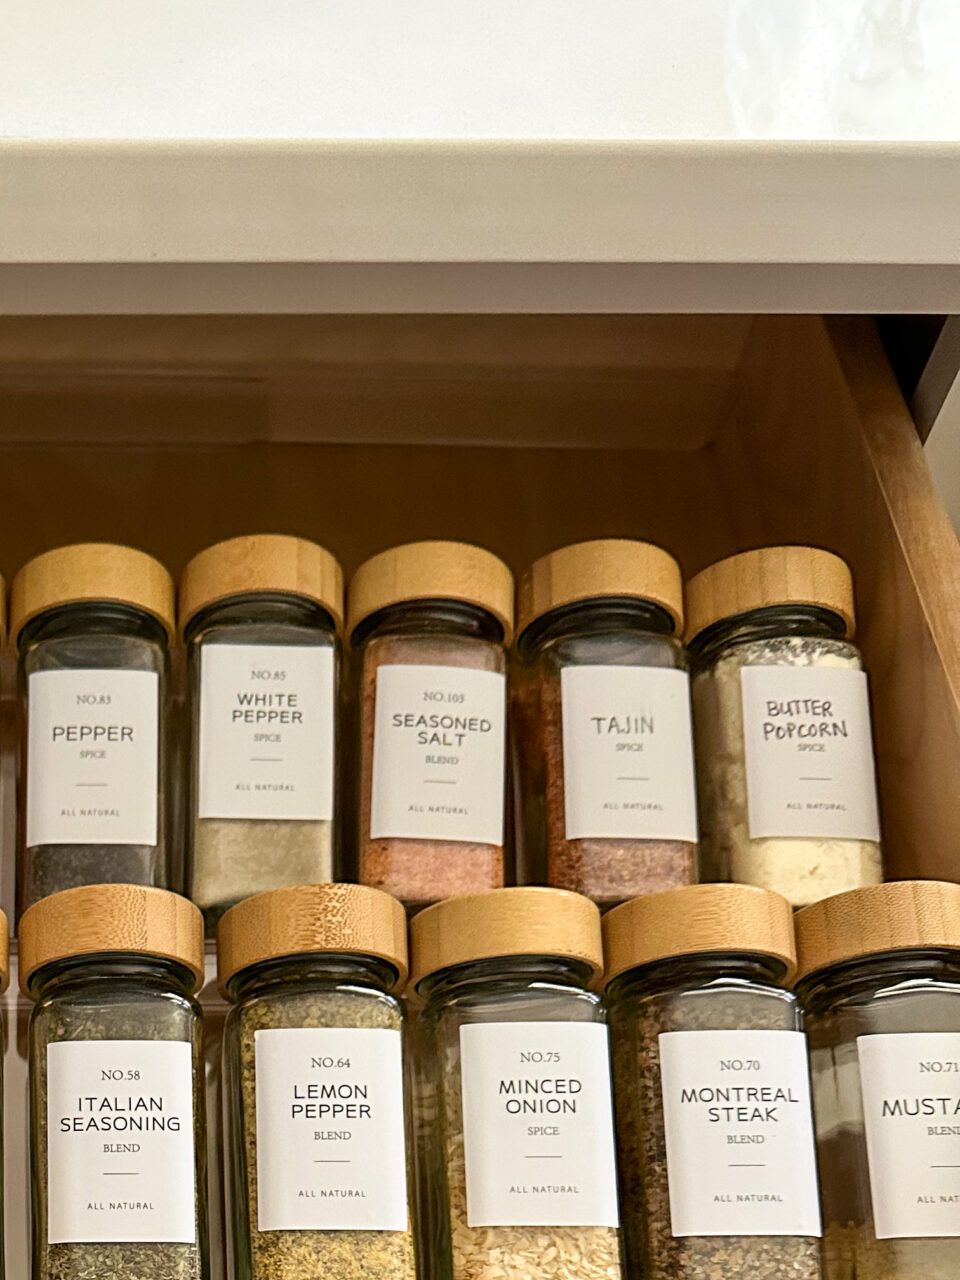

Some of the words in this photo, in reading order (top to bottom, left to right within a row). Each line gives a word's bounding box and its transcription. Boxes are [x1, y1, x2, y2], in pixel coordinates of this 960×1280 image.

[236, 692, 298, 708] WHITE
[765, 698, 834, 718] BUTTER
[231, 708, 304, 725] PEPPER
[392, 713, 492, 733] SEASONED
[52, 724, 134, 743] PEPPER
[762, 719, 849, 742] POPCORN
[253, 732, 282, 743] SPICE
[417, 730, 466, 747] SALT
[615, 742, 644, 752] SPICE
[797, 742, 826, 753] SPICE
[79, 749, 107, 759] SPICE
[425, 754, 460, 766] BLEND
[235, 783, 251, 792] ALL
[254, 783, 295, 792] NATURAL
[60, 809, 76, 817] ALL
[79, 808, 120, 817] NATURAL
[407, 804, 425, 813] ALL
[427, 805, 469, 816] NATURAL
[603, 802, 619, 810] ALL
[622, 802, 663, 812] NATURAL
[786, 802, 803, 810] ALL
[805, 802, 847, 812] NATURAL
[310, 1056, 352, 1070] NO.64
[519, 1051, 561, 1064] NO.75
[719, 1059, 761, 1072] NO.70
[918, 1061, 960, 1073] NO.71
[100, 1069, 141, 1082] NO.58
[293, 1083, 368, 1100] LEMON
[498, 1078, 583, 1095] MINCED
[680, 1086, 800, 1104] MONTREAL
[78, 1096, 164, 1113] ITALIAN
[505, 1098, 577, 1115] ONION
[291, 1103, 372, 1120] PEPPER
[707, 1106, 780, 1123] STEAK
[59, 1115, 181, 1133] SEASONING
[313, 1130, 352, 1141] BLEND
[527, 1125, 561, 1137] SPICE
[726, 1134, 766, 1145] BLEND
[102, 1143, 141, 1154] BLEND
[297, 1189, 317, 1198] ALL
[320, 1189, 367, 1198] NATURAL
[509, 1185, 529, 1194] ALL
[532, 1185, 580, 1194] NATURAL
[713, 1194, 733, 1203] ALL
[735, 1193, 784, 1203] NATURAL
[916, 1195, 937, 1204] ALL
[86, 1201, 105, 1211] ALL
[108, 1201, 155, 1211] NATURAL
